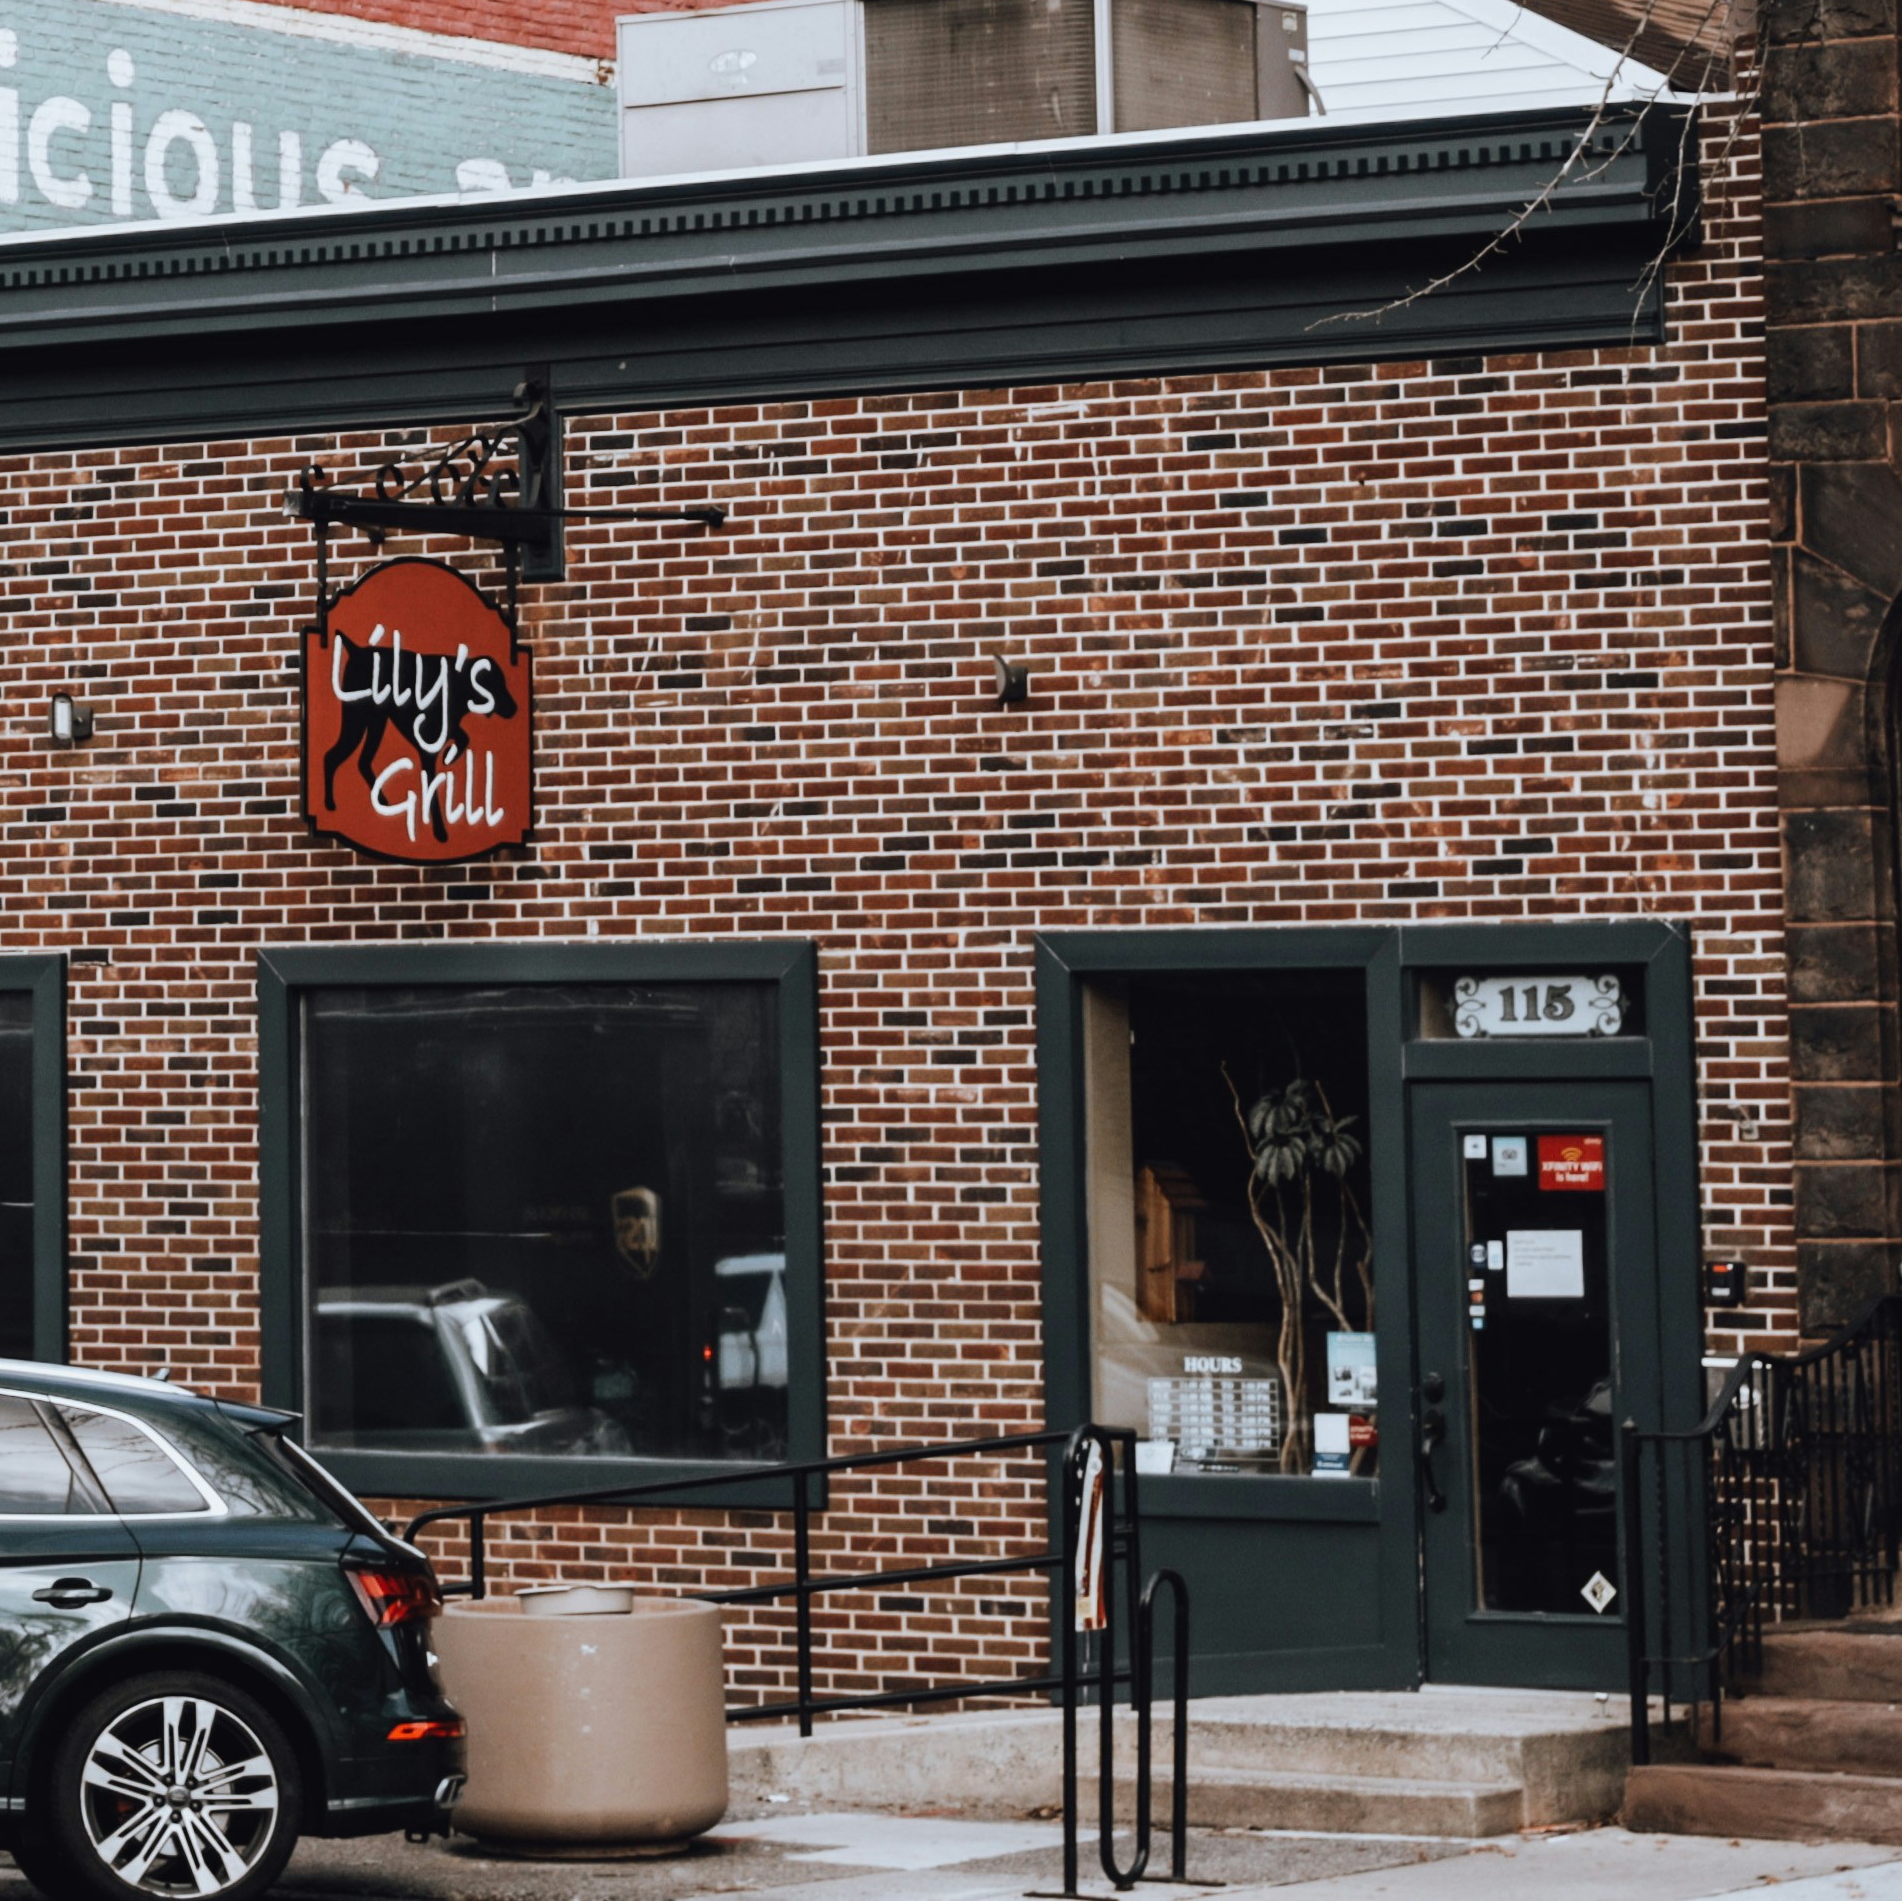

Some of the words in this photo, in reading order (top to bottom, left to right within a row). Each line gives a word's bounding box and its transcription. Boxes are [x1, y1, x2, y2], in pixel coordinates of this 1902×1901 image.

[331, 624, 496, 752] Lily's
[370, 744, 504, 842] Grill
[1499, 984, 1575, 1023] 115
[1183, 1356, 1243, 1373] HOURS
